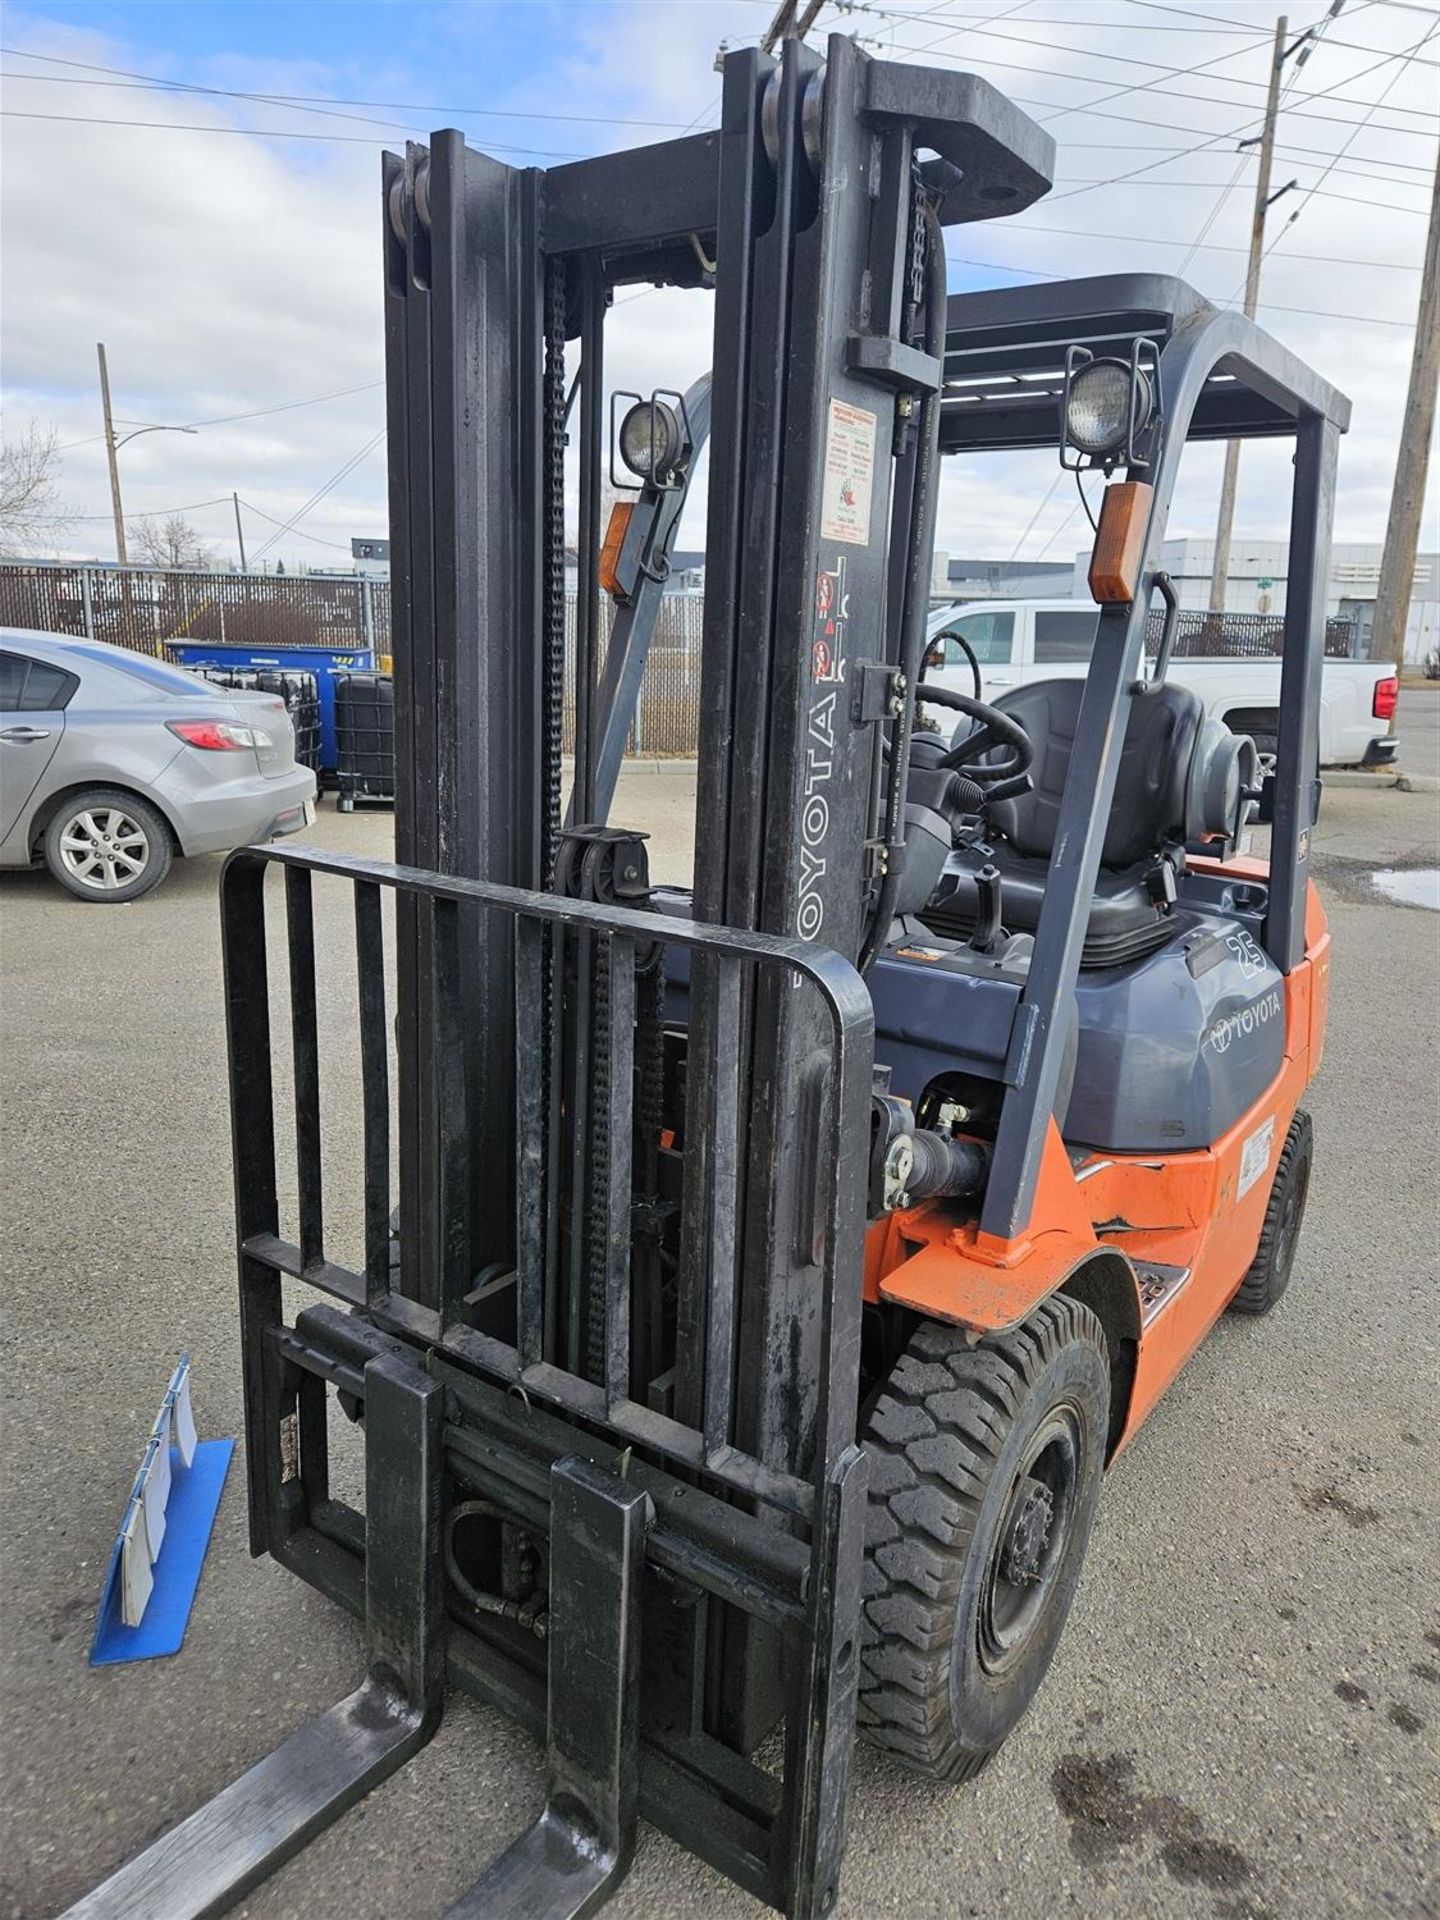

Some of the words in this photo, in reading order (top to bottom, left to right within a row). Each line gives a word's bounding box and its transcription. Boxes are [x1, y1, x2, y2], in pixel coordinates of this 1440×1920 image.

[793, 691, 837, 989] OYOTA
[1226, 931, 1267, 980] 25
[1229, 991, 1281, 1038] TOYOTA
